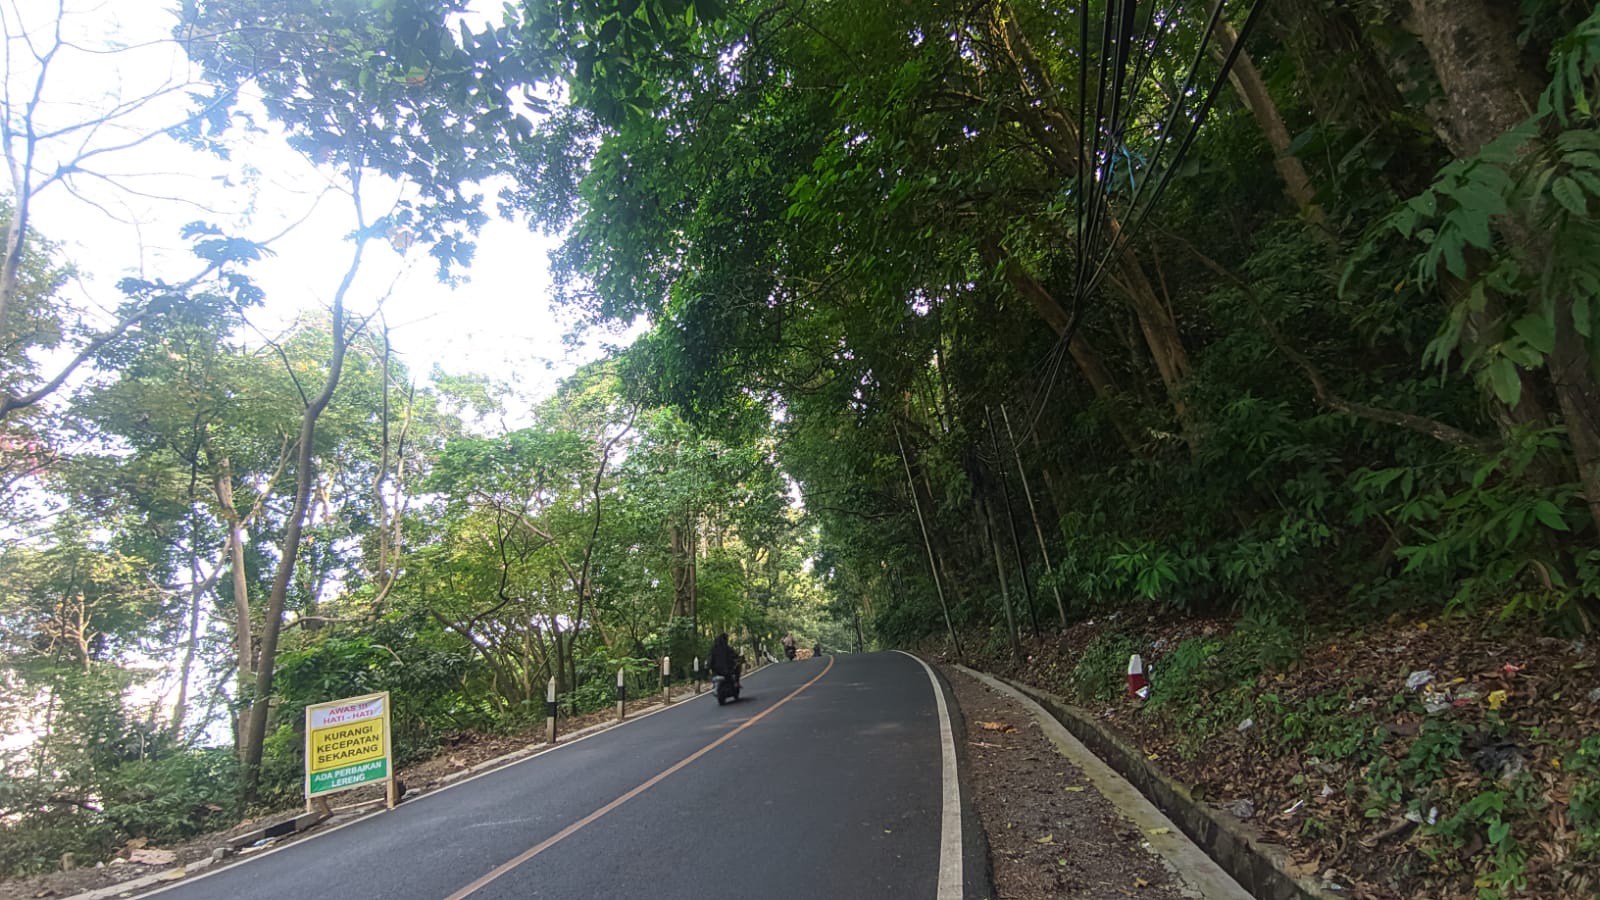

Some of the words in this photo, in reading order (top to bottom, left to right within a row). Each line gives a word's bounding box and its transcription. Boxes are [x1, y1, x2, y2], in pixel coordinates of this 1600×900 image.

[323, 715, 345, 725] HATI
[352, 709, 374, 719] HATI
[329, 705, 356, 715] AWAS
[324, 725, 373, 742] KURANGI
[316, 734, 379, 753] KECEPATAN
[318, 744, 378, 764] SEKARANG
[314, 772, 333, 782] ADA
[334, 761, 382, 778] PERBAIKAN
[331, 773, 366, 787] LERENG
